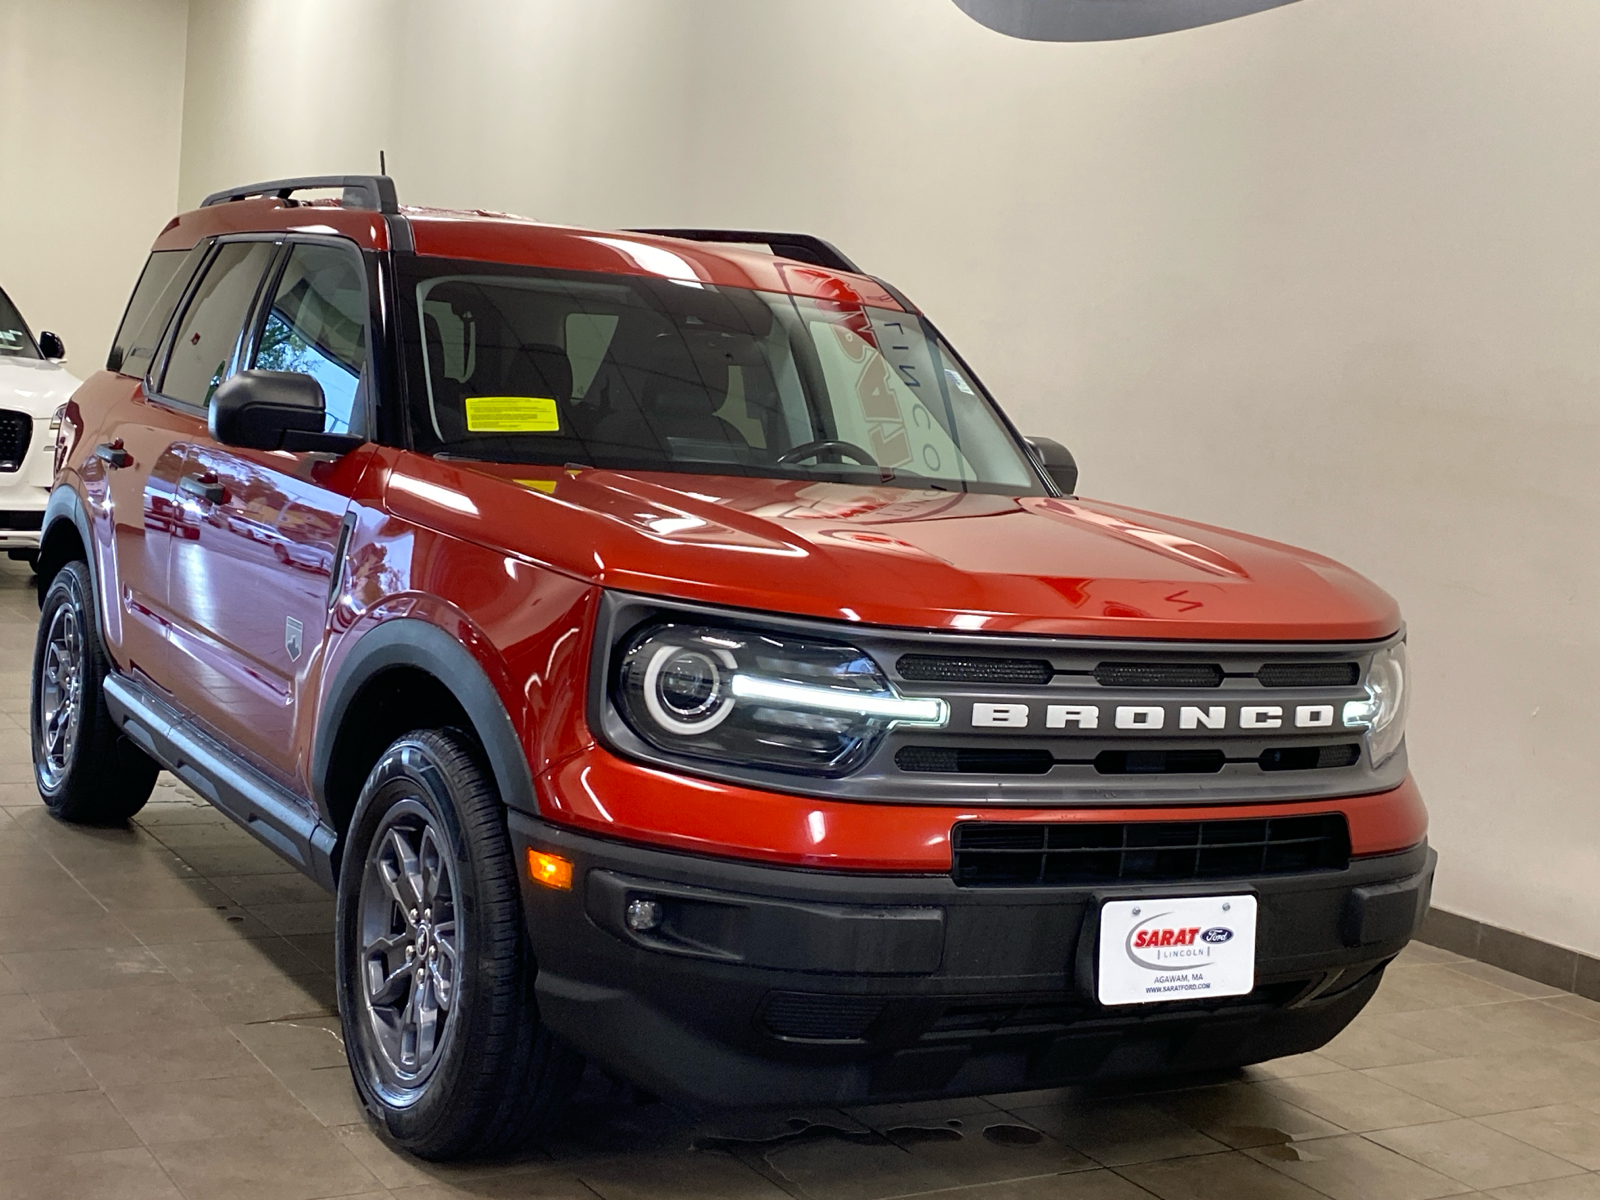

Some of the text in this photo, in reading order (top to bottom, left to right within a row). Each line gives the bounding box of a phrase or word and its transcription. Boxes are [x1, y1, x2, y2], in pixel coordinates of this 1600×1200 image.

[971, 702, 1334, 730] BRONCO
[1133, 927, 1201, 948] SARAT
[1163, 949, 1204, 958] LINCOLN
[1154, 973, 1204, 984] AGAWAM, MA
[1145, 983, 1211, 994] WWW.SARATFORD.COM
